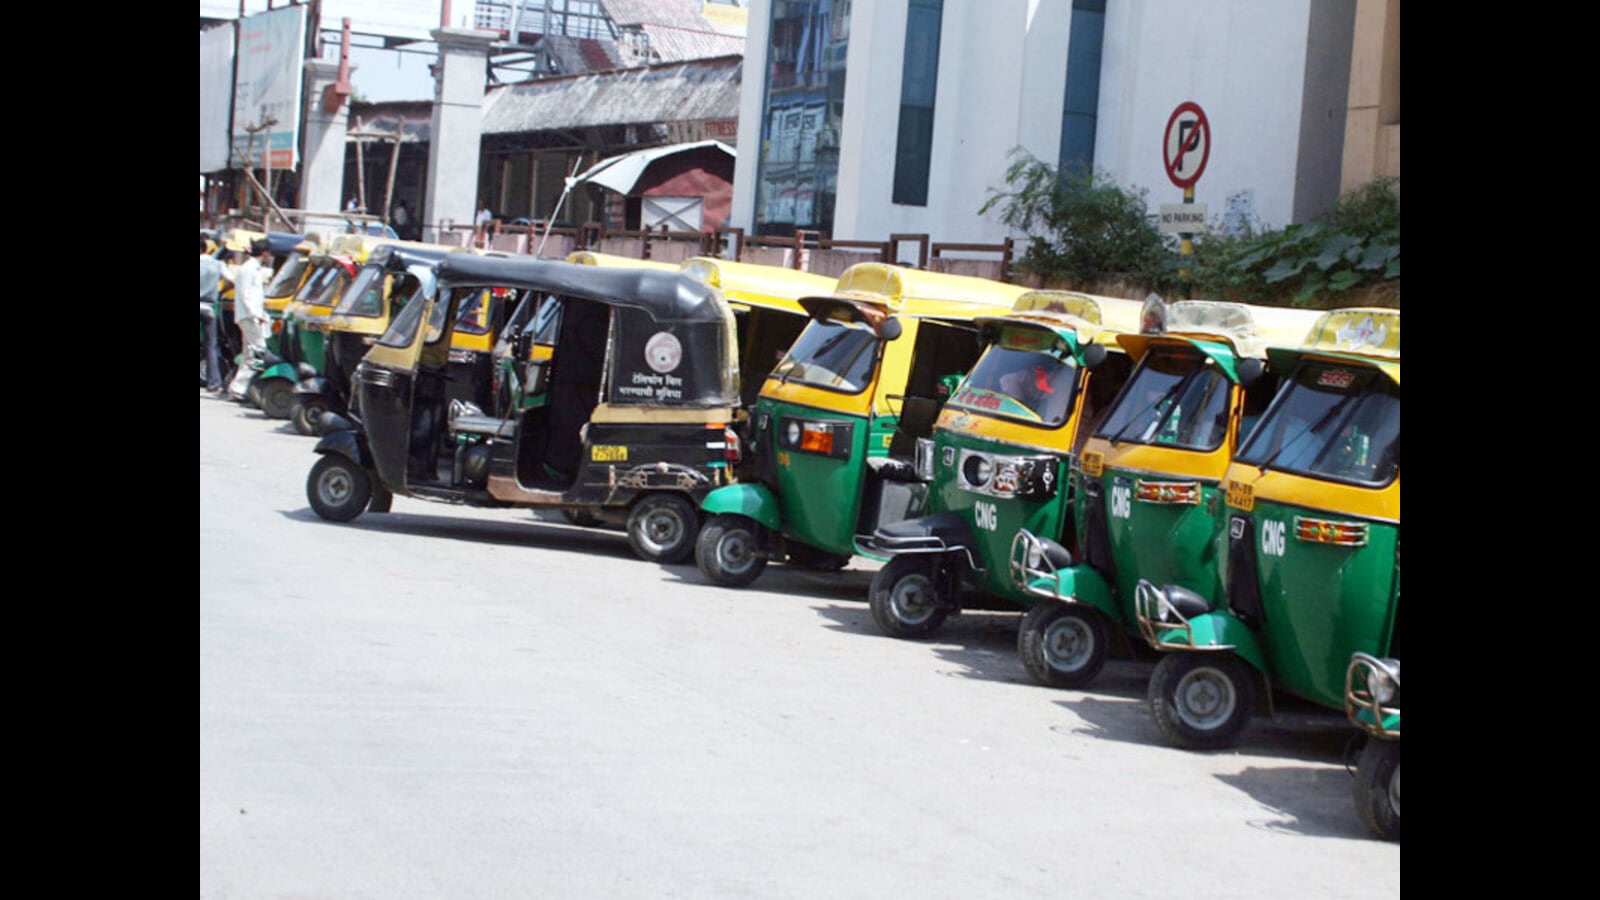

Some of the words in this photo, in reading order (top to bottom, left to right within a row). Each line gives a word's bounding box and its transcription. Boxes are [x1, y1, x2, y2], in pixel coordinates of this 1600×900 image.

[1162, 214, 1172, 223] NO
[1174, 212, 1204, 225] PARKING
[975, 501, 997, 531] CNG
[1111, 486, 1131, 519] CNG
[1262, 519, 1286, 557] CNG
